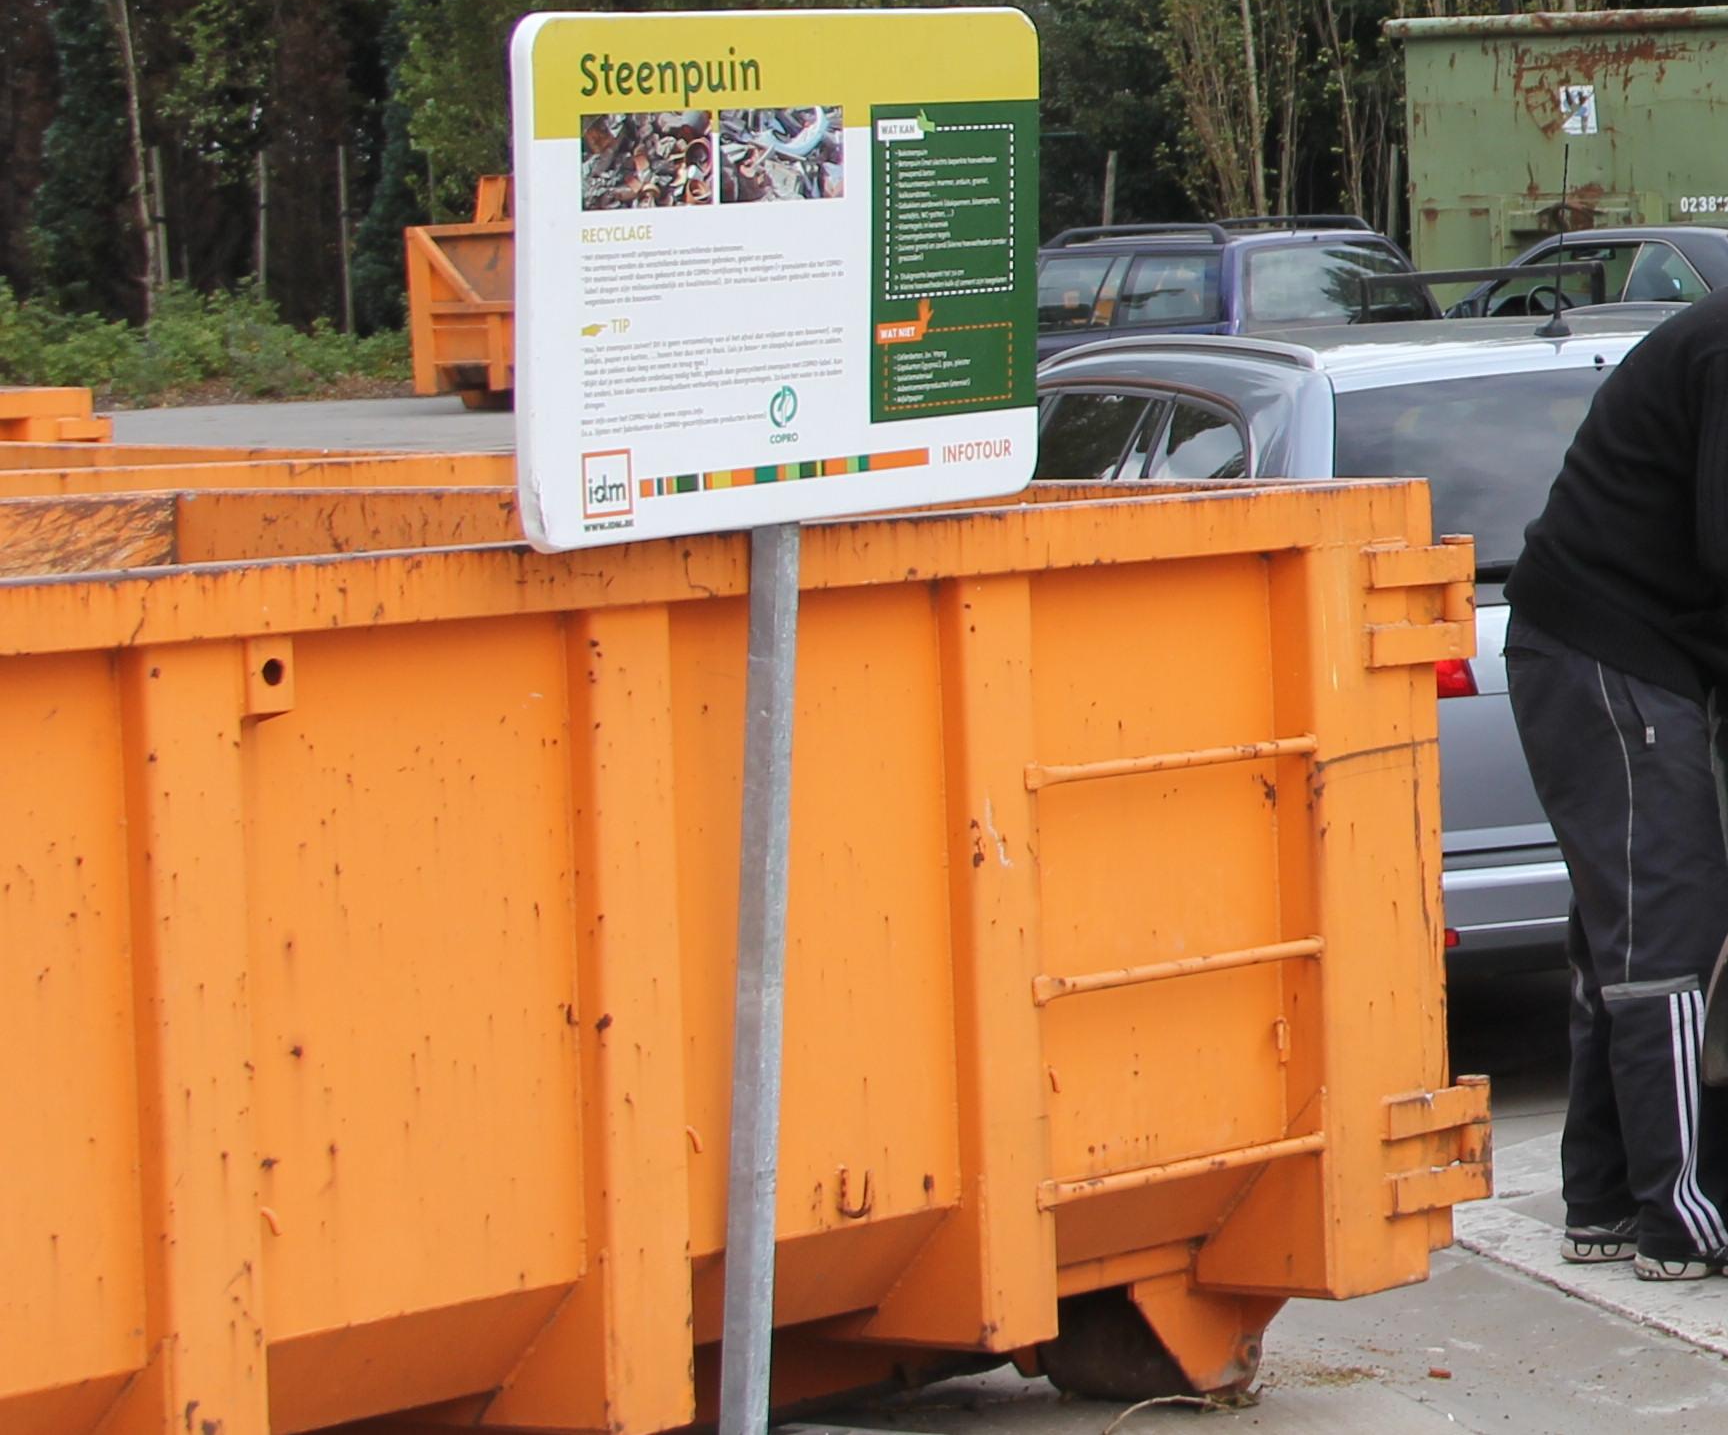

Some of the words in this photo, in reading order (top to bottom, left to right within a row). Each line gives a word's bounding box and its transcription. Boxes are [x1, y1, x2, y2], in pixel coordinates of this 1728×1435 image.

[580, 46, 762, 106] Steenpuin
[881, 124, 897, 135] WAT
[899, 123, 915, 134] KAN
[581, 224, 653, 244] RECYCLAGE
[611, 317, 631, 334] TIP
[880, 327, 897, 339] WAT
[898, 326, 916, 338] NIET
[769, 431, 799, 445] COPRO
[942, 438, 1012, 464] INFOTOUR
[588, 474, 627, 504] idm
